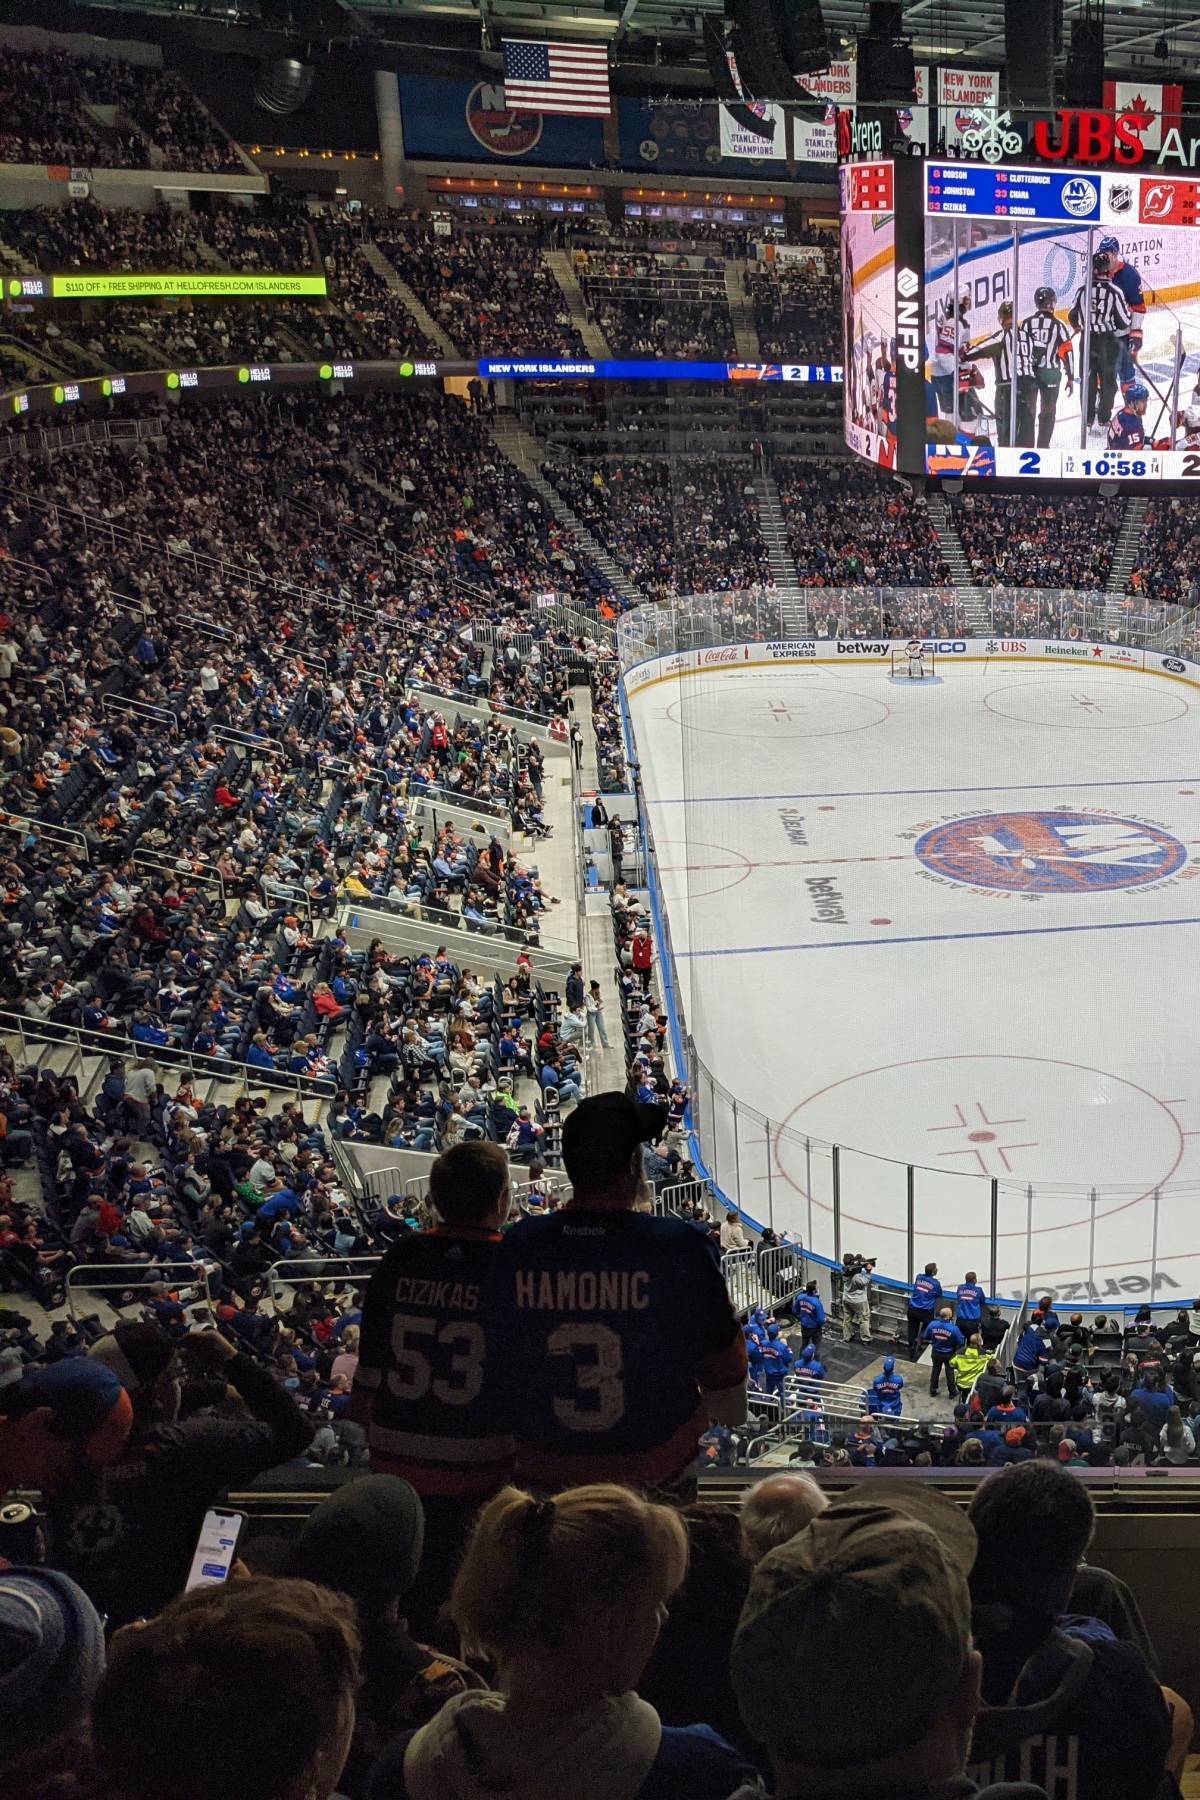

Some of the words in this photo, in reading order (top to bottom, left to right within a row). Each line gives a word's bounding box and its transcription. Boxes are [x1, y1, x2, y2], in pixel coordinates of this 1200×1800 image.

[943, 71, 964, 84] NEW
[969, 74, 992, 88] YORK
[943, 90, 993, 104] ISLANDERS
[732, 134, 760, 144] STANLEY
[852, 116, 882, 152] Arena
[1035, 110, 1144, 165] UBS
[733, 144, 774, 156] CHAMPIONS
[804, 138, 833, 149] STANLEY
[943, 170, 968, 180] DOBSON
[943, 186, 975, 196] JOHNSTON
[1010, 190, 1030, 200] CHARA
[943, 203, 966, 212] CIZIKAS
[1010, 206, 1036, 216] SOROKIN
[66, 283, 84, 292] $110
[86, 282, 100, 291] OFF
[109, 282, 127, 290] FREE
[128, 281, 162, 290] SHIPPING
[164, 281, 174, 290] AT
[898, 301, 919, 370] NFP
[488, 364, 510, 372] NEW
[512, 364, 538, 372] YORK
[539, 364, 595, 373] ISLANDERS
[790, 368, 802, 378] 2
[865, 434, 872, 456] 2
[1127, 432, 1140, 446] 15
[1018, 452, 1041, 474] 2
[1066, 462, 1074, 472] 12
[1082, 460, 1146, 476] 10:58
[1151, 463, 1159, 474] 14
[1182, 455, 1200, 477] 2
[766, 642, 816, 650] AMERICAN
[836, 642, 890, 656] betway
[1001, 642, 1027, 653] UBS
[1045, 646, 1088, 656] Heineken
[773, 650, 816, 658] EXPRESS
[1166, 660, 1183, 672] Ford
[910, 818, 938, 834] UBS
[940, 808, 994, 822] Arena
[1083, 805, 1121, 818] UBS
[1124, 812, 1174, 832] Arena
[914, 870, 965, 890] Arena
[1124, 878, 1178, 896] Arena
[966, 886, 1012, 900] UBS
[804, 876, 849, 926] betway
[562, 1224, 606, 1236] Reebok
[396, 1277, 480, 1312] CIZIKAS
[515, 1270, 651, 1312] HAMONIC
[387, 1313, 487, 1406] 53
[548, 1322, 626, 1432] 3
